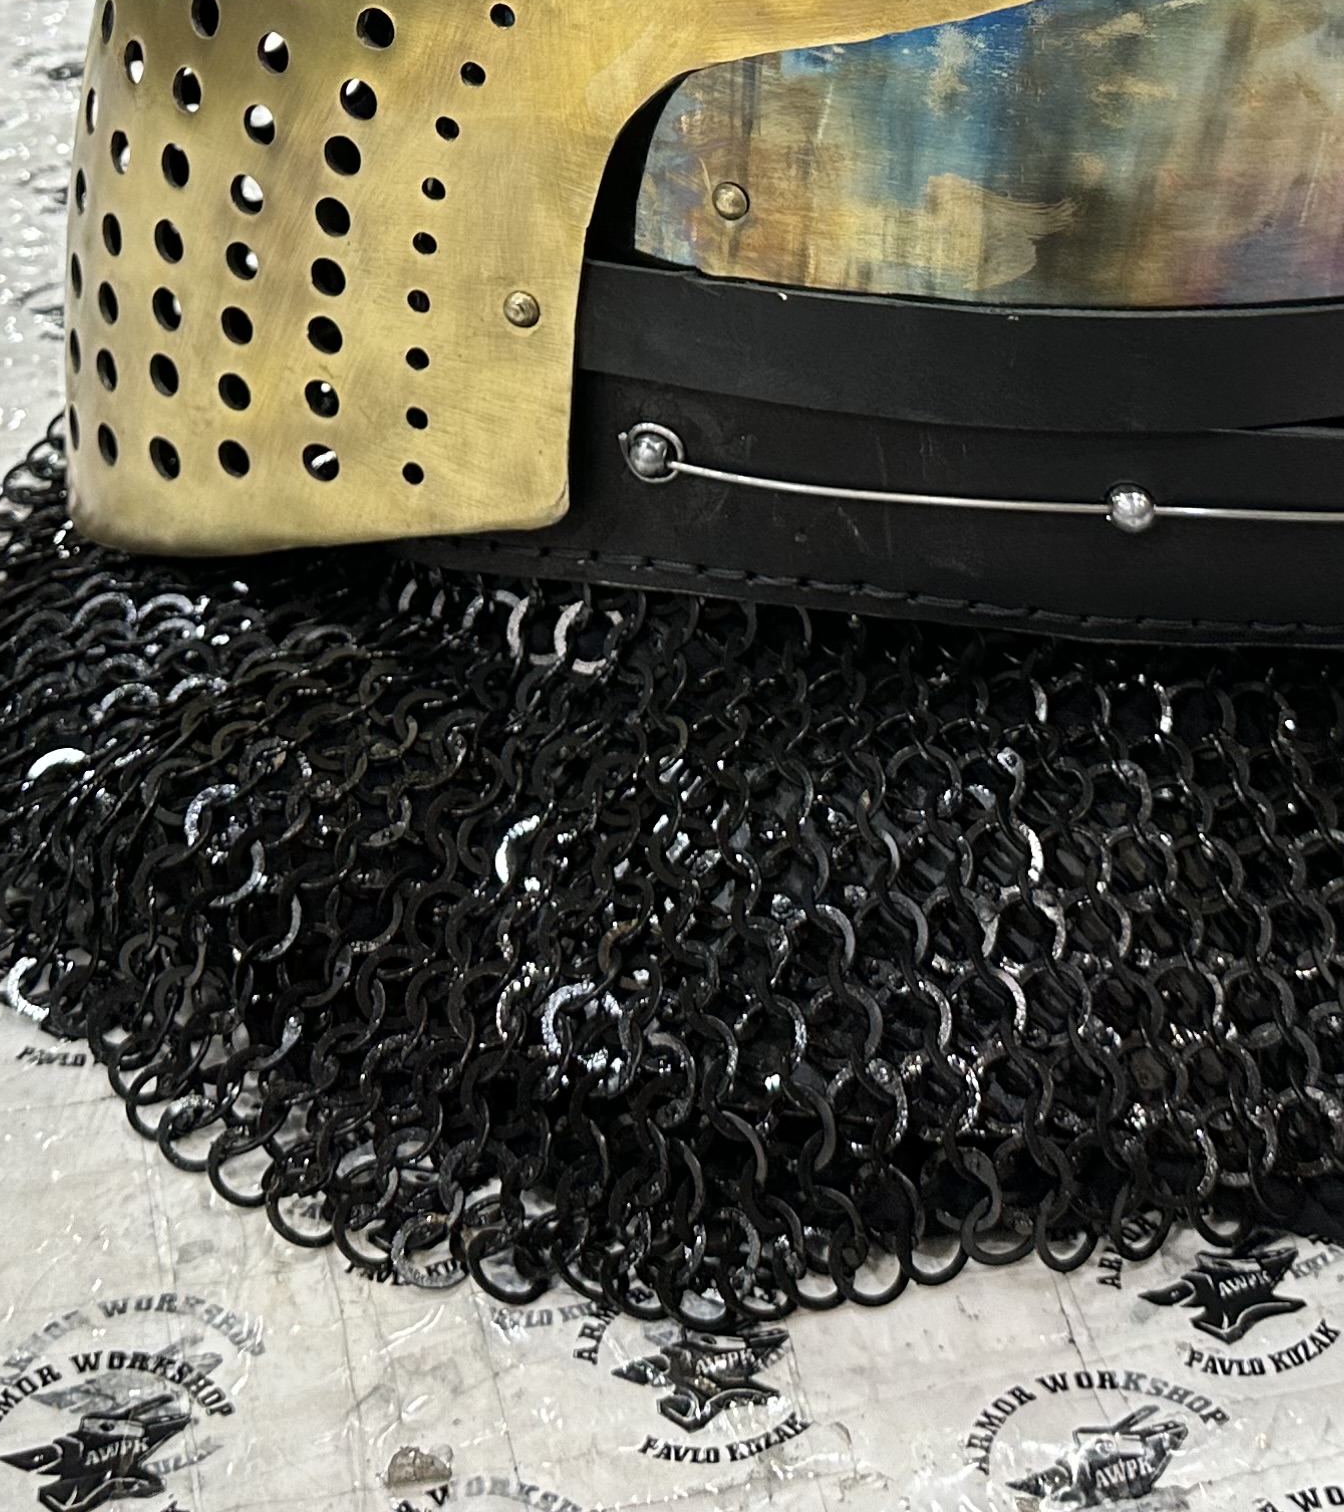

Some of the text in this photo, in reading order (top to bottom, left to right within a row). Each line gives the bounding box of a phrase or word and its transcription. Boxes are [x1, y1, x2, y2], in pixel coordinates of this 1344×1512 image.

[1184, 1318, 1341, 1377] PAVLO KOZAK
[70, 1350, 236, 1417] WORKSHOP
[1035, 1370, 1231, 1426] WORKSHOP
[85, 1439, 150, 1466] AWPK
[637, 1434, 721, 1464] PAVLO
